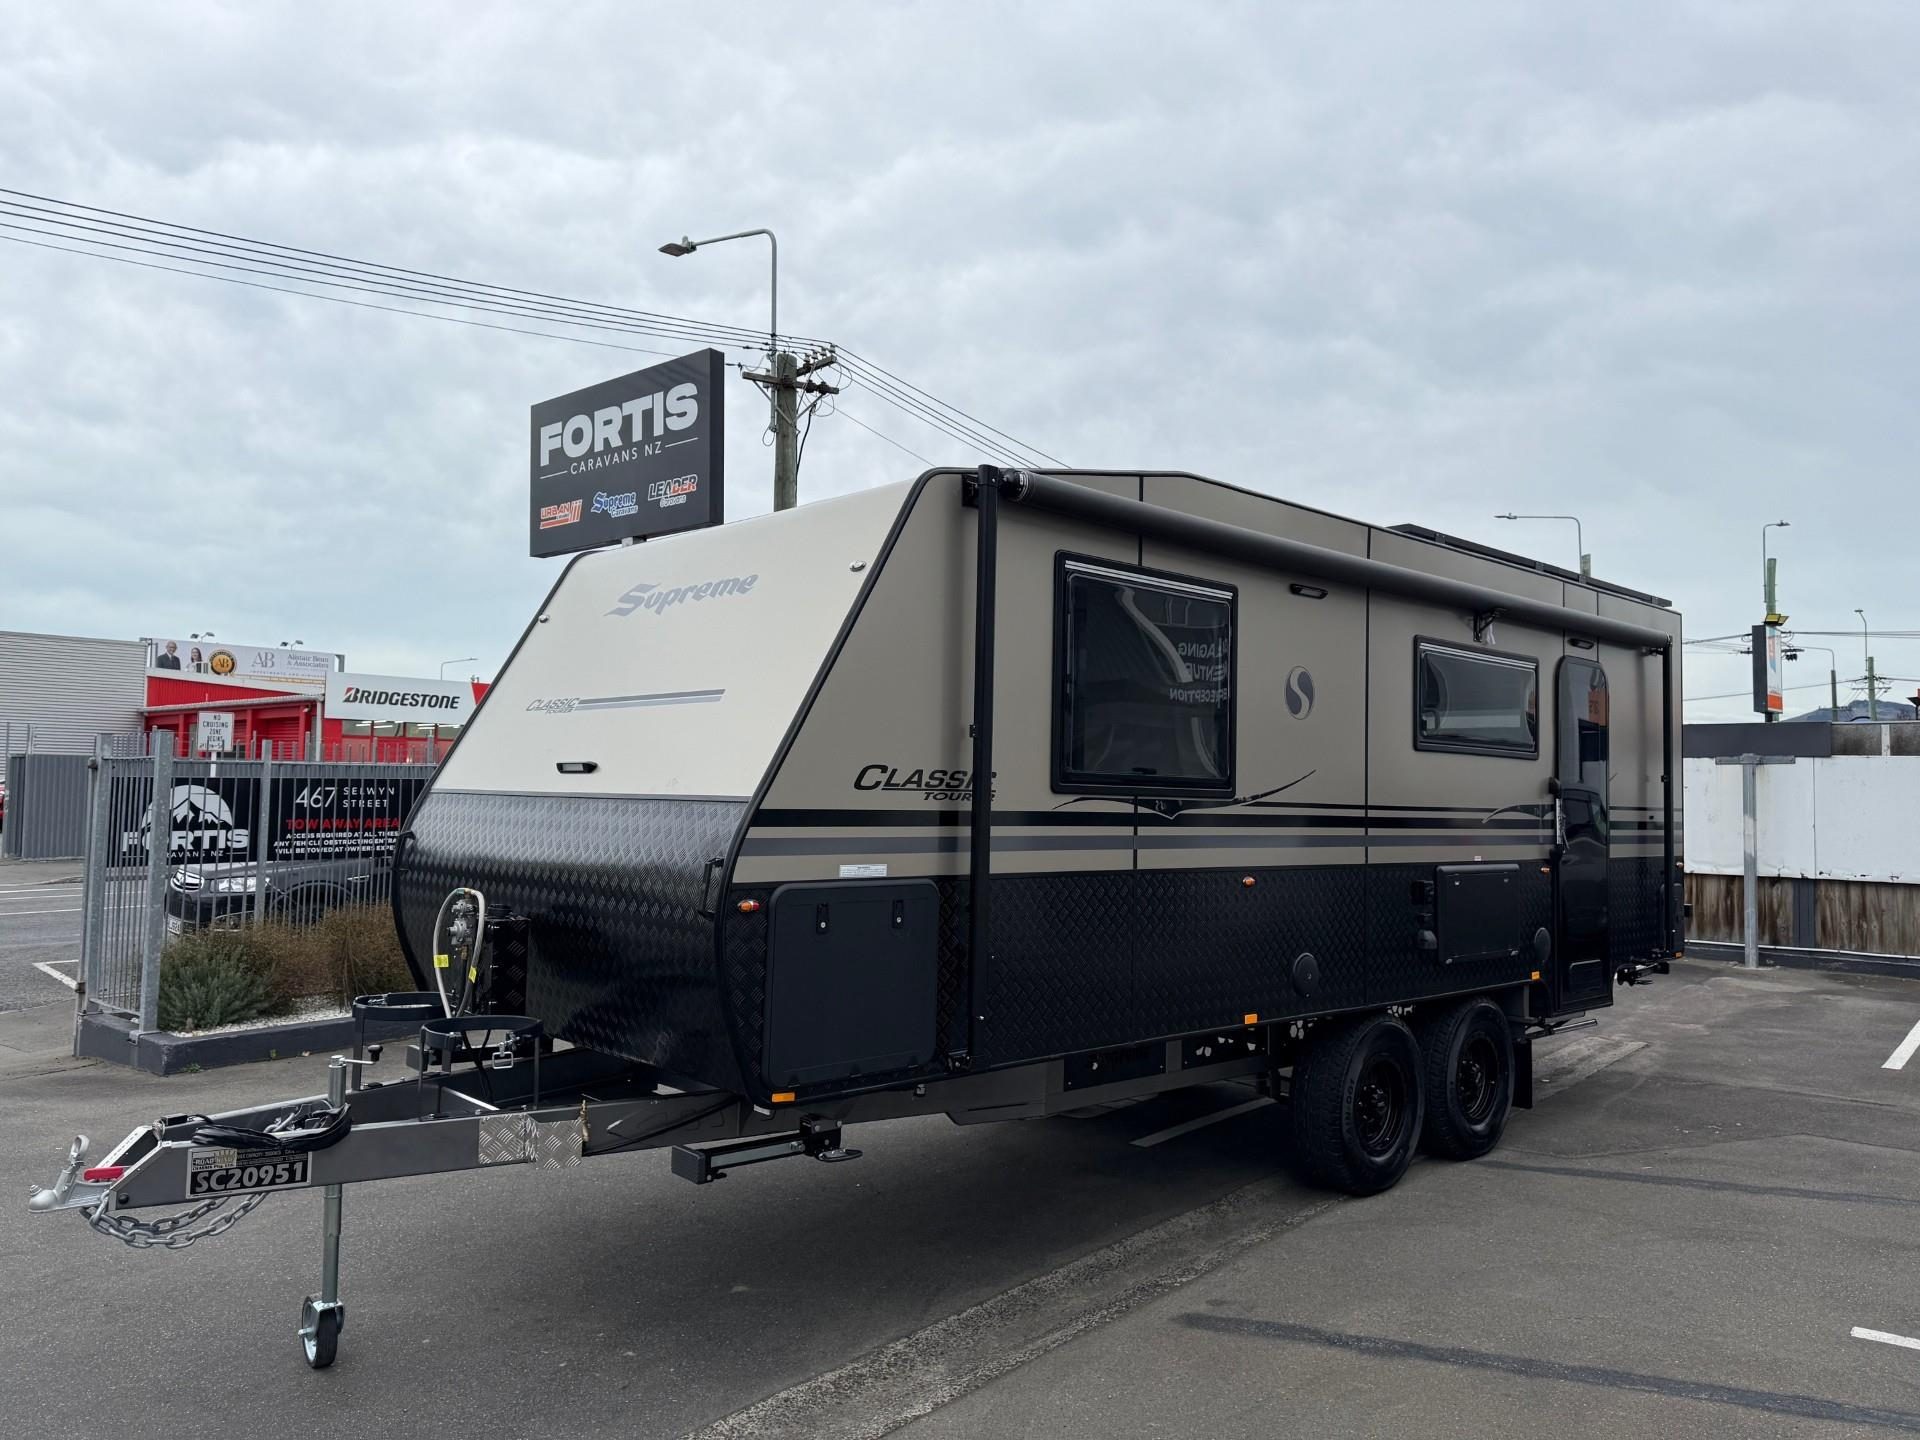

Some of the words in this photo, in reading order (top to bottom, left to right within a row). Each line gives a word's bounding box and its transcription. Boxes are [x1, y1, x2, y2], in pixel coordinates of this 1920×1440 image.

[540, 382, 699, 467] FORTIS
[570, 447, 639, 475] CARAVANS
[644, 441, 663, 458] NZ
[647, 474, 698, 501] LEADER
[591, 491, 637, 513] Supreme
[603, 574, 759, 617] Supreme
[343, 687, 460, 709] BRIDGESTONE
[526, 697, 580, 711] CLASSIC
[854, 764, 997, 790] CLASSI
[295, 786, 337, 808] 467
[343, 786, 395, 796] SELWYN
[343, 799, 388, 808] STREET
[285, 818, 319, 830] TOW
[322, 818, 362, 829] AWAY
[363, 817, 399, 828] AREA
[196, 1162, 304, 1193] SC20951
